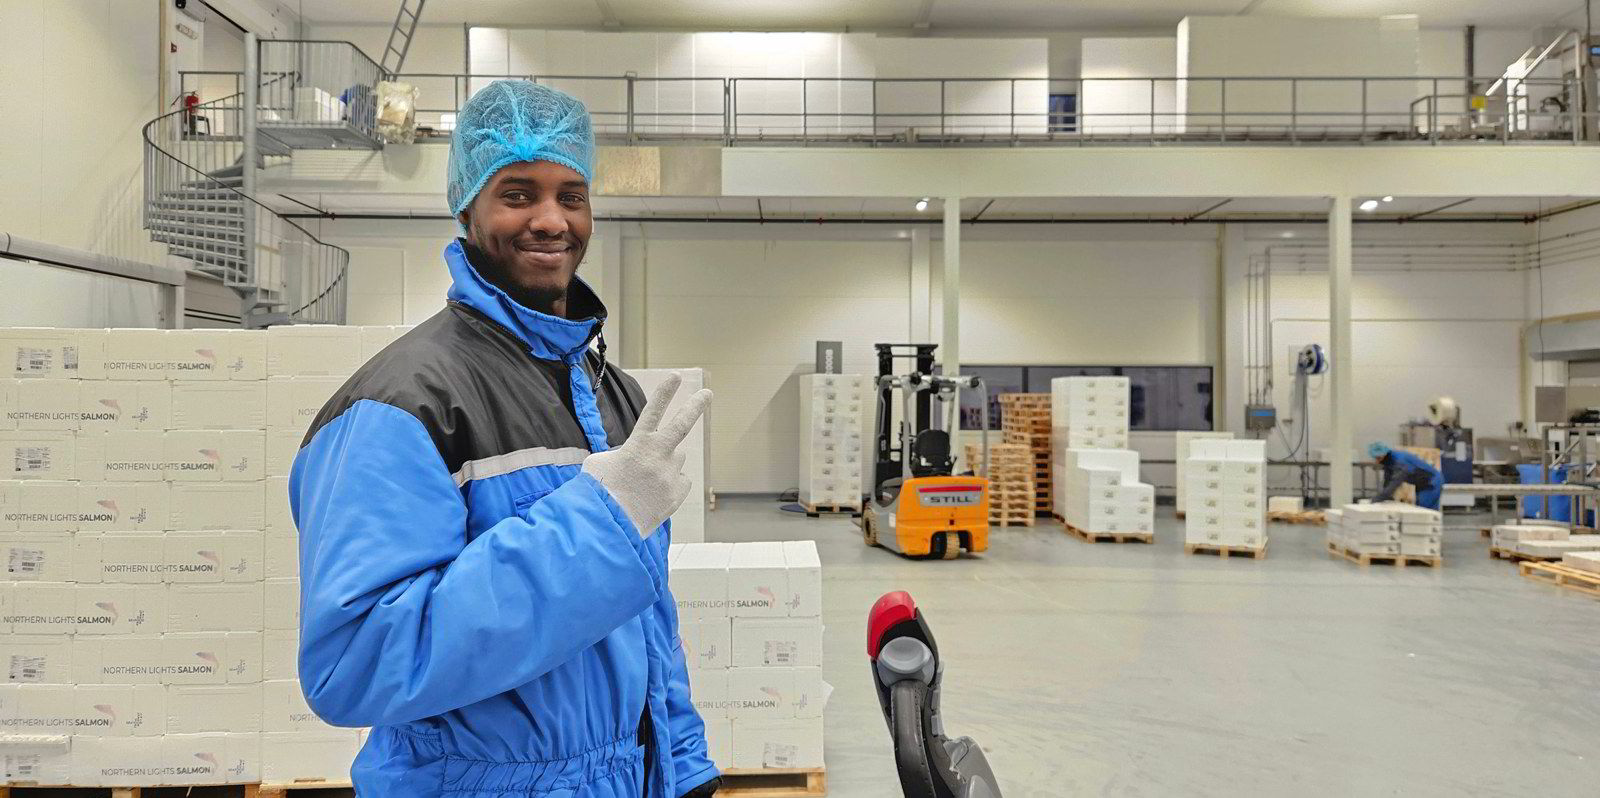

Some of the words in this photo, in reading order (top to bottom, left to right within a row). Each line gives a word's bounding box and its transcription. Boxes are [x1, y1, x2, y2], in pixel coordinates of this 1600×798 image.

[7, 412, 51, 420] NORTHERN
[52, 412, 80, 420] LIGHTS
[81, 412, 115, 420] SALMON
[106, 462, 150, 470] NORTHERN
[152, 462, 179, 470] LIGHTS
[180, 462, 214, 470] SALMON
[5, 514, 48, 522] NORTHERN
[50, 514, 78, 522] LIGHTS
[78, 514, 112, 522] SALMON
[104, 564, 148, 572] NORTHERN
[150, 564, 178, 572] LIGHTS
[179, 564, 213, 572] SALMON
[710, 600, 735, 608] LIGHTS
[736, 600, 769, 608] SALMON
[3, 616, 46, 624] NORTHERN
[49, 616, 76, 624] LIGHTS
[77, 616, 111, 624] SALMON
[103, 666, 147, 674] NORTHERN
[149, 666, 176, 674] LIGHTS
[178, 666, 212, 674] SALMON
[1, 718, 44, 726] NORTHERN
[46, 718, 74, 726] LIGHTS
[75, 718, 109, 726] SALMON
[102, 767, 146, 776] NORTHERN
[148, 767, 174, 776] LIGHTS
[176, 767, 210, 776] SALMON
